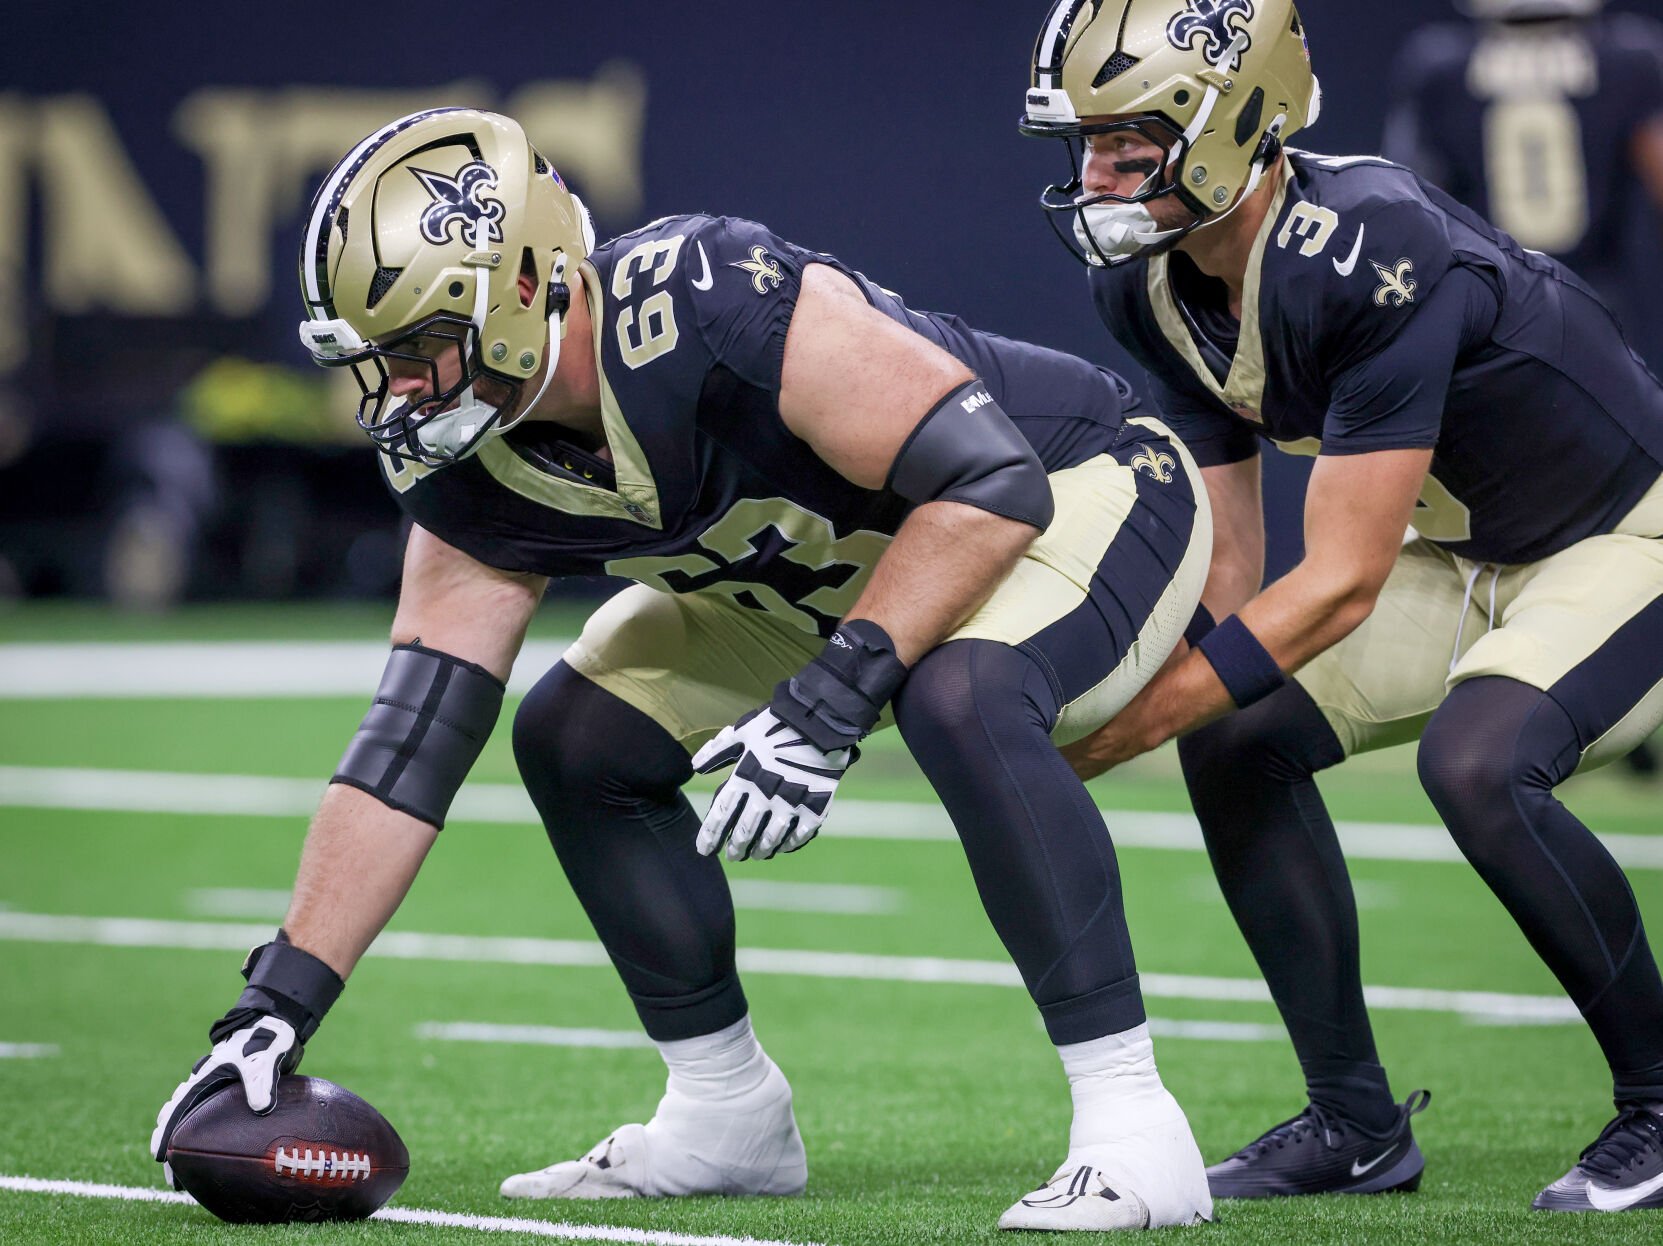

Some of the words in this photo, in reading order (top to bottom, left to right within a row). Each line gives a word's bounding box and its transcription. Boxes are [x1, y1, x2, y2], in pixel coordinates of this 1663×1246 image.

[1277, 200, 1339, 258] 3
[612, 234, 685, 371] 63
[605, 496, 895, 636] 63
